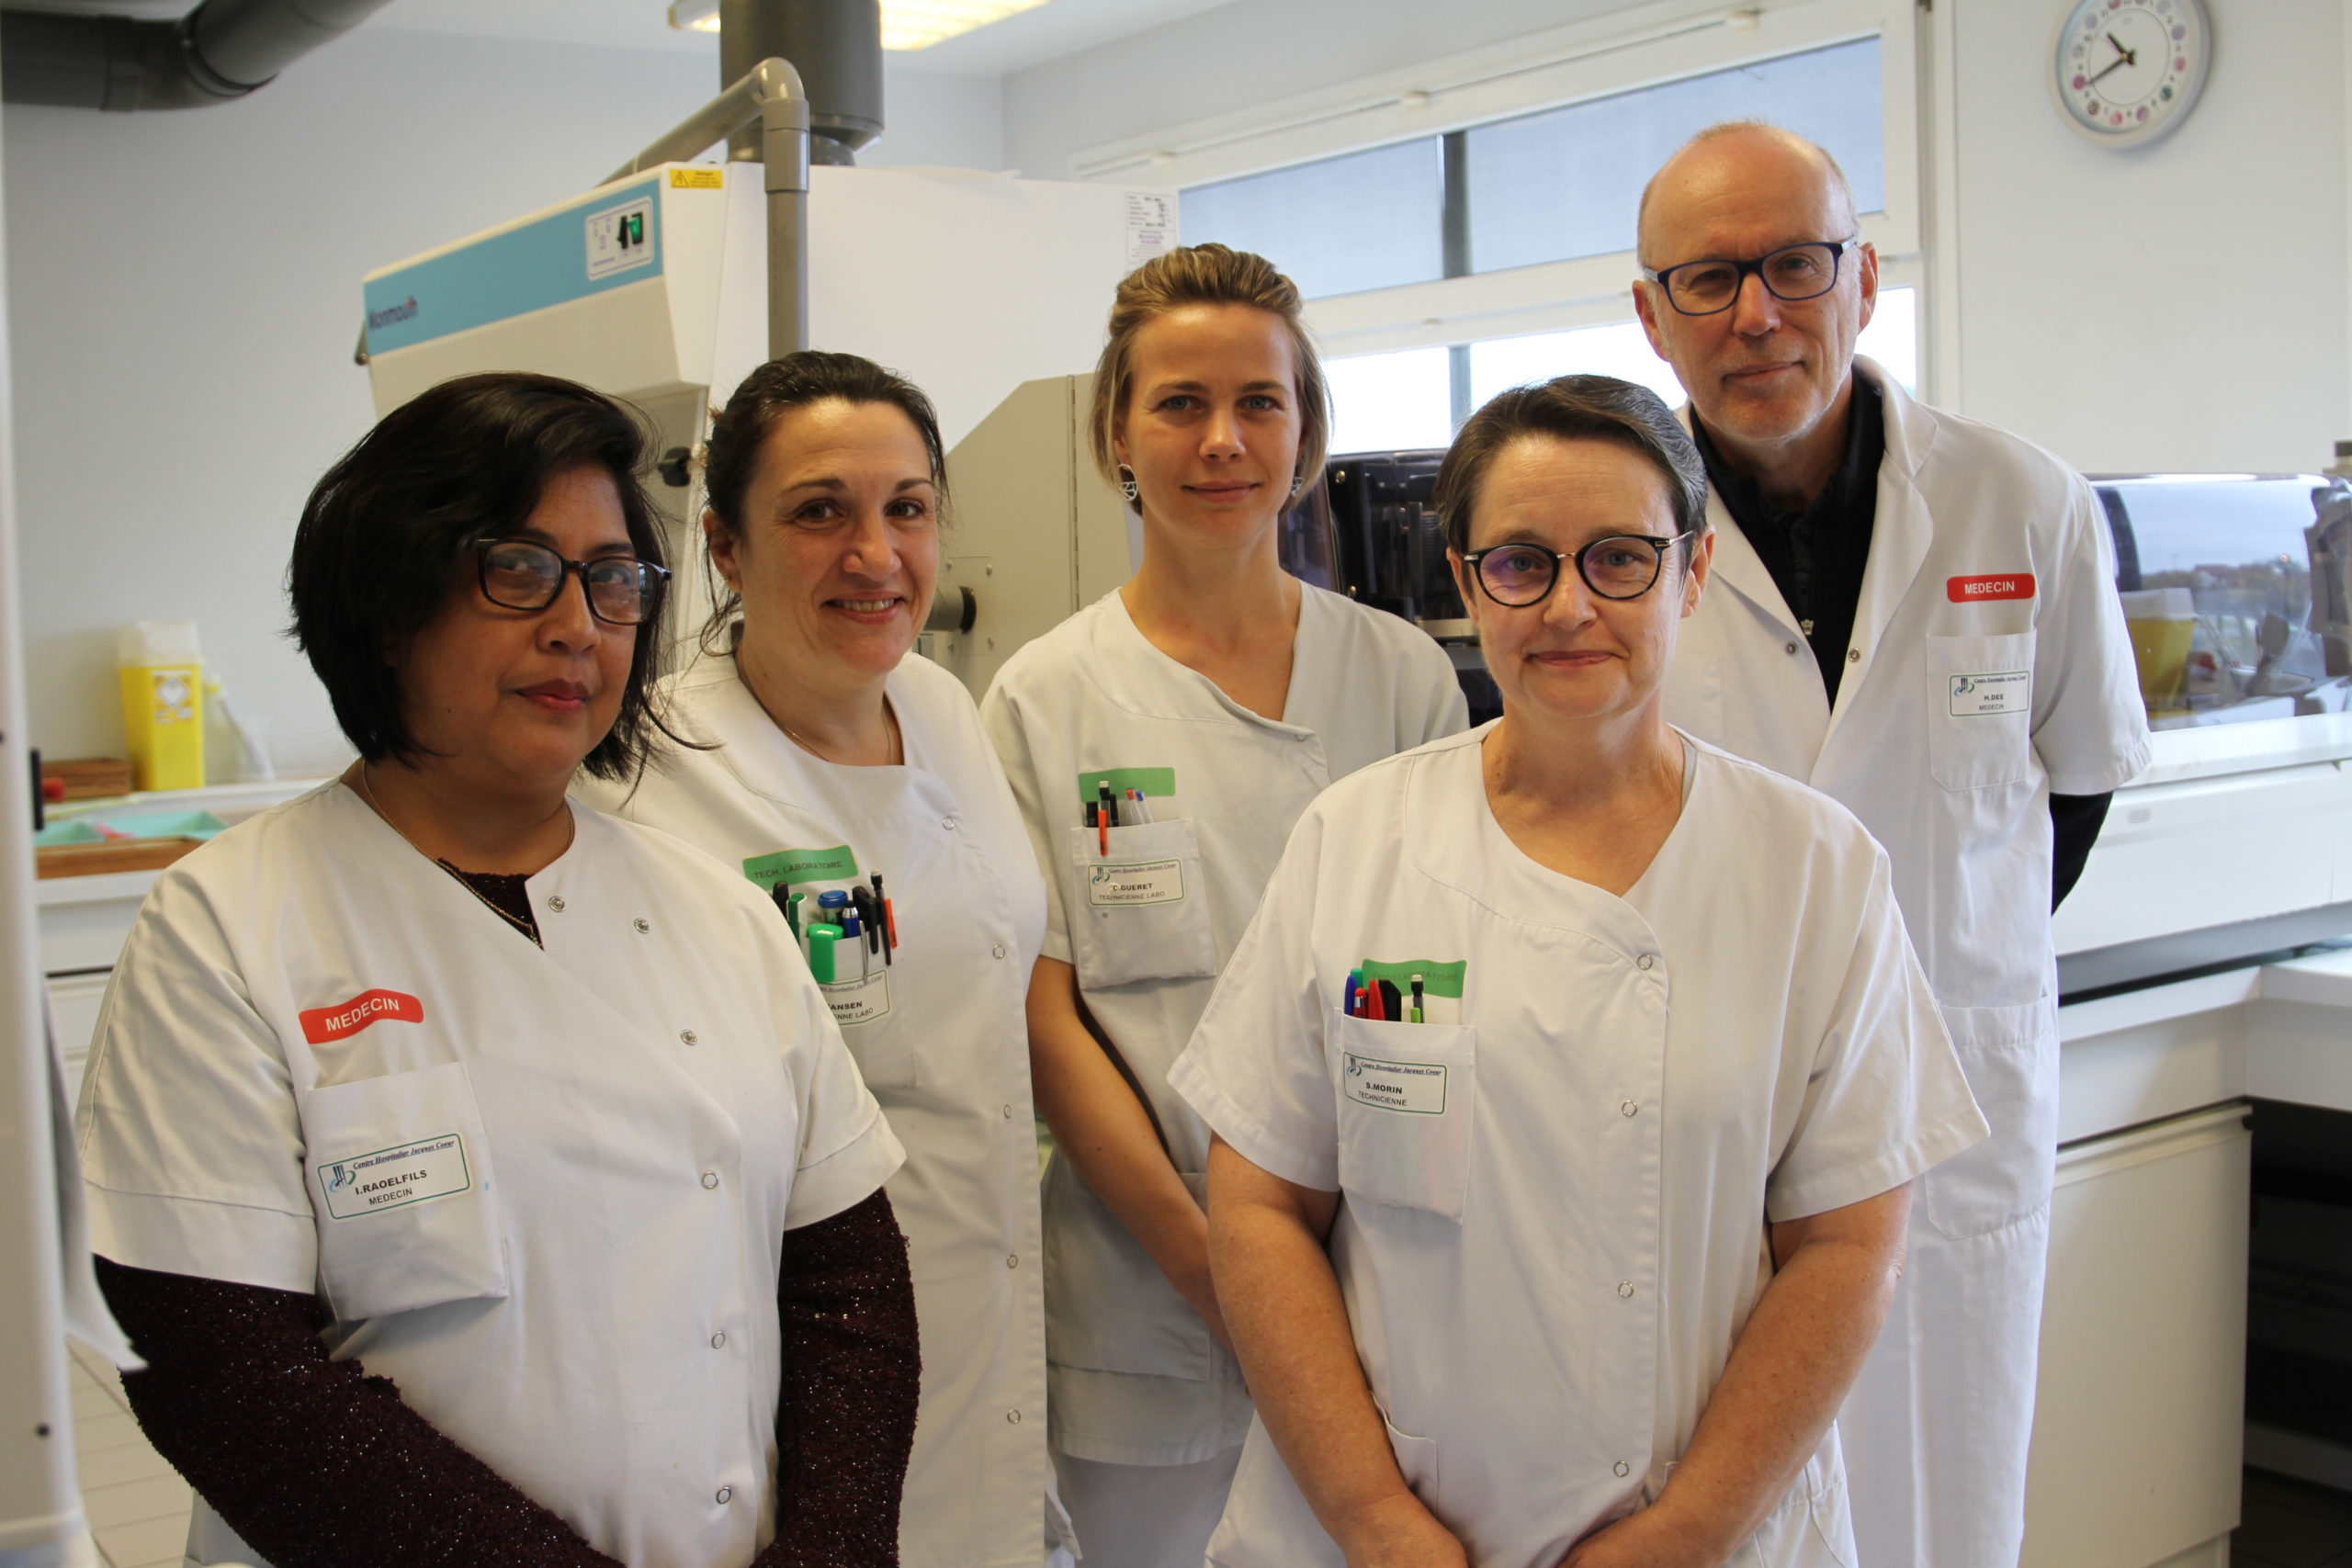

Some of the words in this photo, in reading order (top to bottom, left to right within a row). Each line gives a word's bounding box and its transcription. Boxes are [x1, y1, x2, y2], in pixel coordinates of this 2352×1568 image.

[1964, 581, 2015, 595] MEDECIN
[1978, 703, 2005, 711] MEDECIN
[783, 860, 843, 874] LABORATOIRE
[828, 1000, 863, 1010] ANSEN
[325, 998, 400, 1032] MEDECIN
[855, 1007, 874, 1019] LABO
[1365, 1081, 1403, 1095] S.MORIN
[1358, 1090, 1408, 1107] TECHNICIENNE
[353, 1159, 374, 1170] Centre
[374, 1150, 410, 1166] Hospitalier
[411, 1145, 435, 1156] Jacques
[435, 1140, 456, 1149] Coeur
[355, 1169, 428, 1195] I.RAOELFILS
[368, 1188, 413, 1205] MEDECIN
